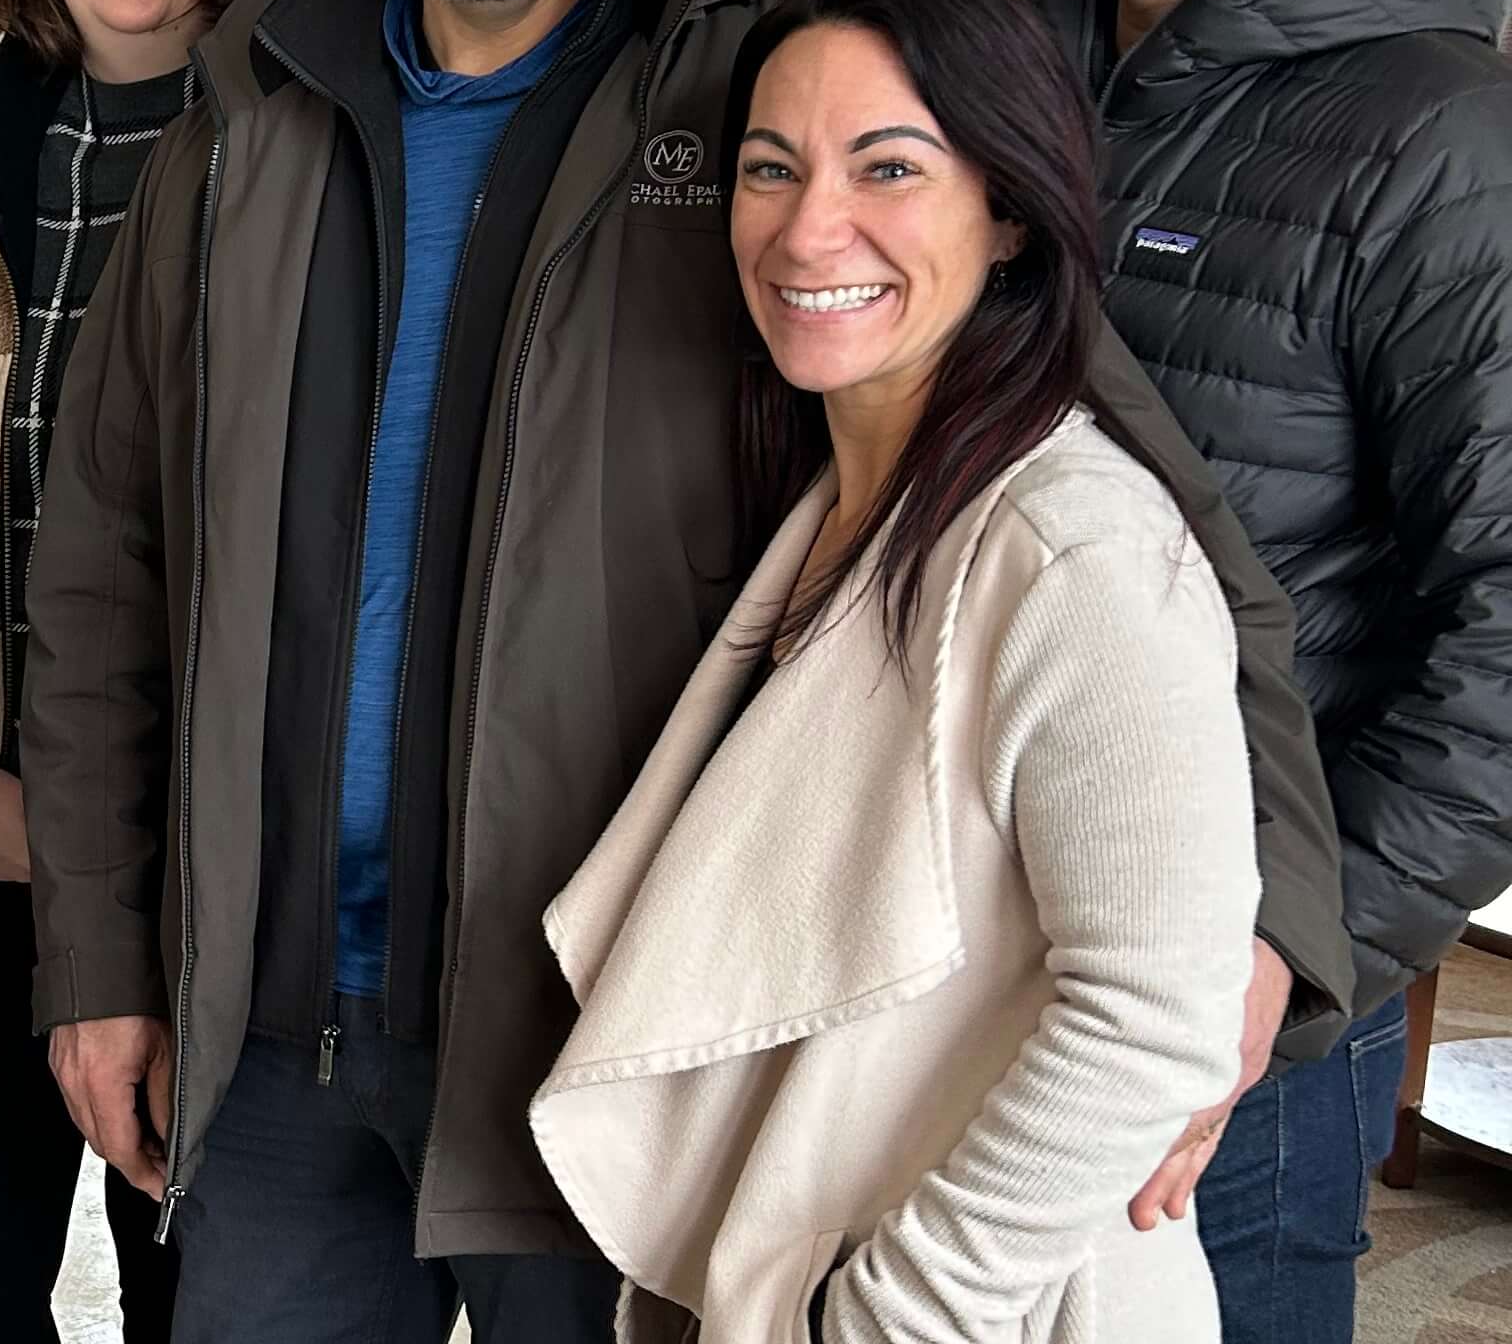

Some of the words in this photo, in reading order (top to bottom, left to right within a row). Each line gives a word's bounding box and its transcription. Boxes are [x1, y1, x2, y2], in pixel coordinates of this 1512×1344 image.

[652, 141, 697, 172] ME
[631, 183, 680, 196] CHAEL
[630, 196, 722, 205] OTOGRAPH
